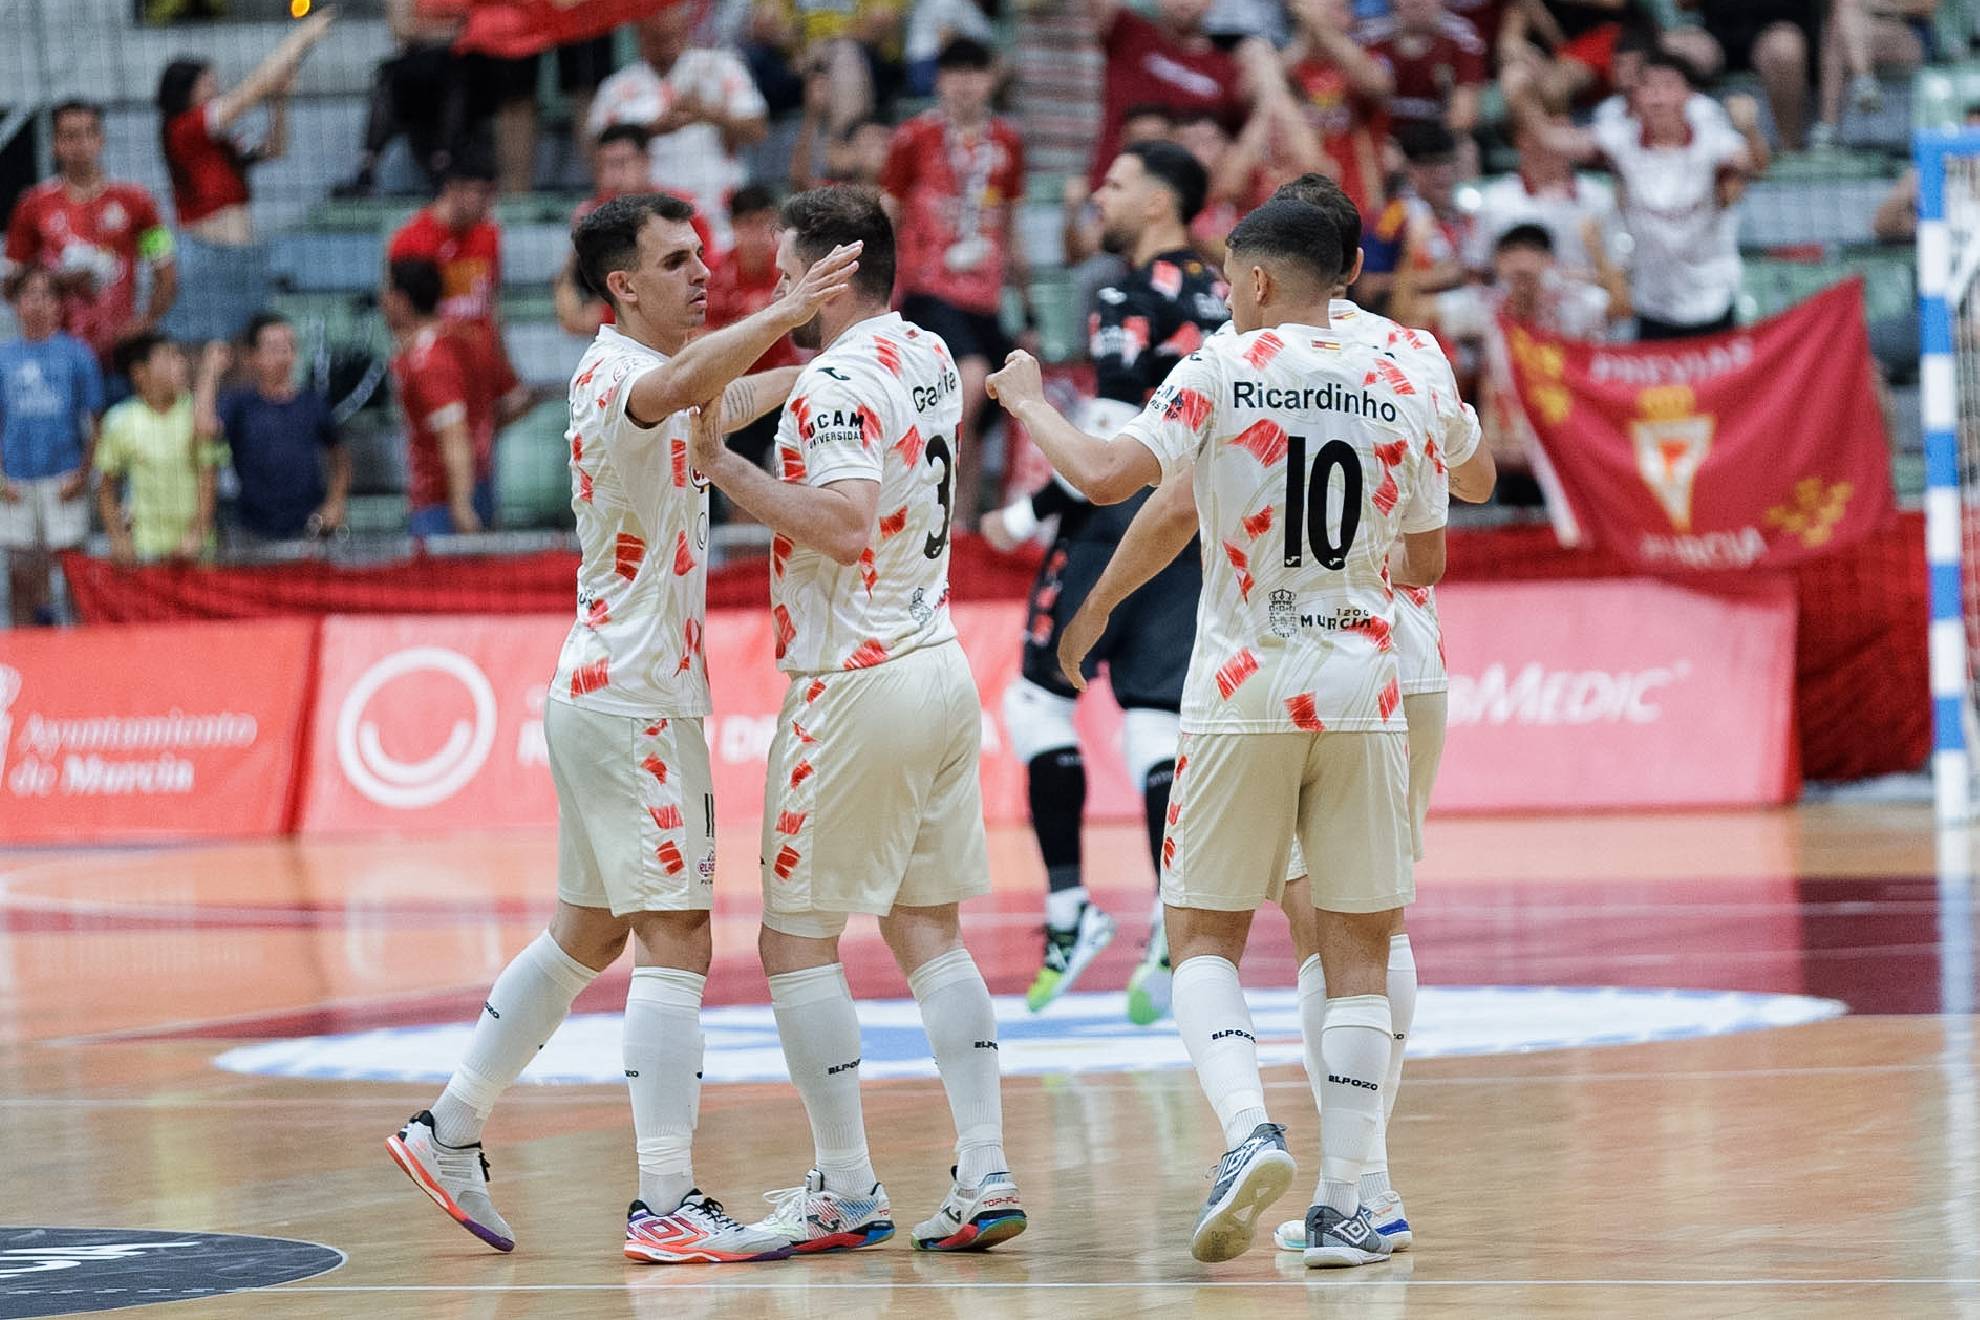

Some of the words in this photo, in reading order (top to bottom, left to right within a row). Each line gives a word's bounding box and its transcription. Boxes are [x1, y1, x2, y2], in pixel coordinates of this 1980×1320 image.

[1233, 381, 1397, 422] Ricardinho
[806, 410, 865, 439] UCAM
[1283, 435, 1364, 571] 10
[1300, 614, 1371, 631] MURCIA
[62, 752, 194, 794] Murcia
[1328, 1074, 1379, 1092] ELPOZO
